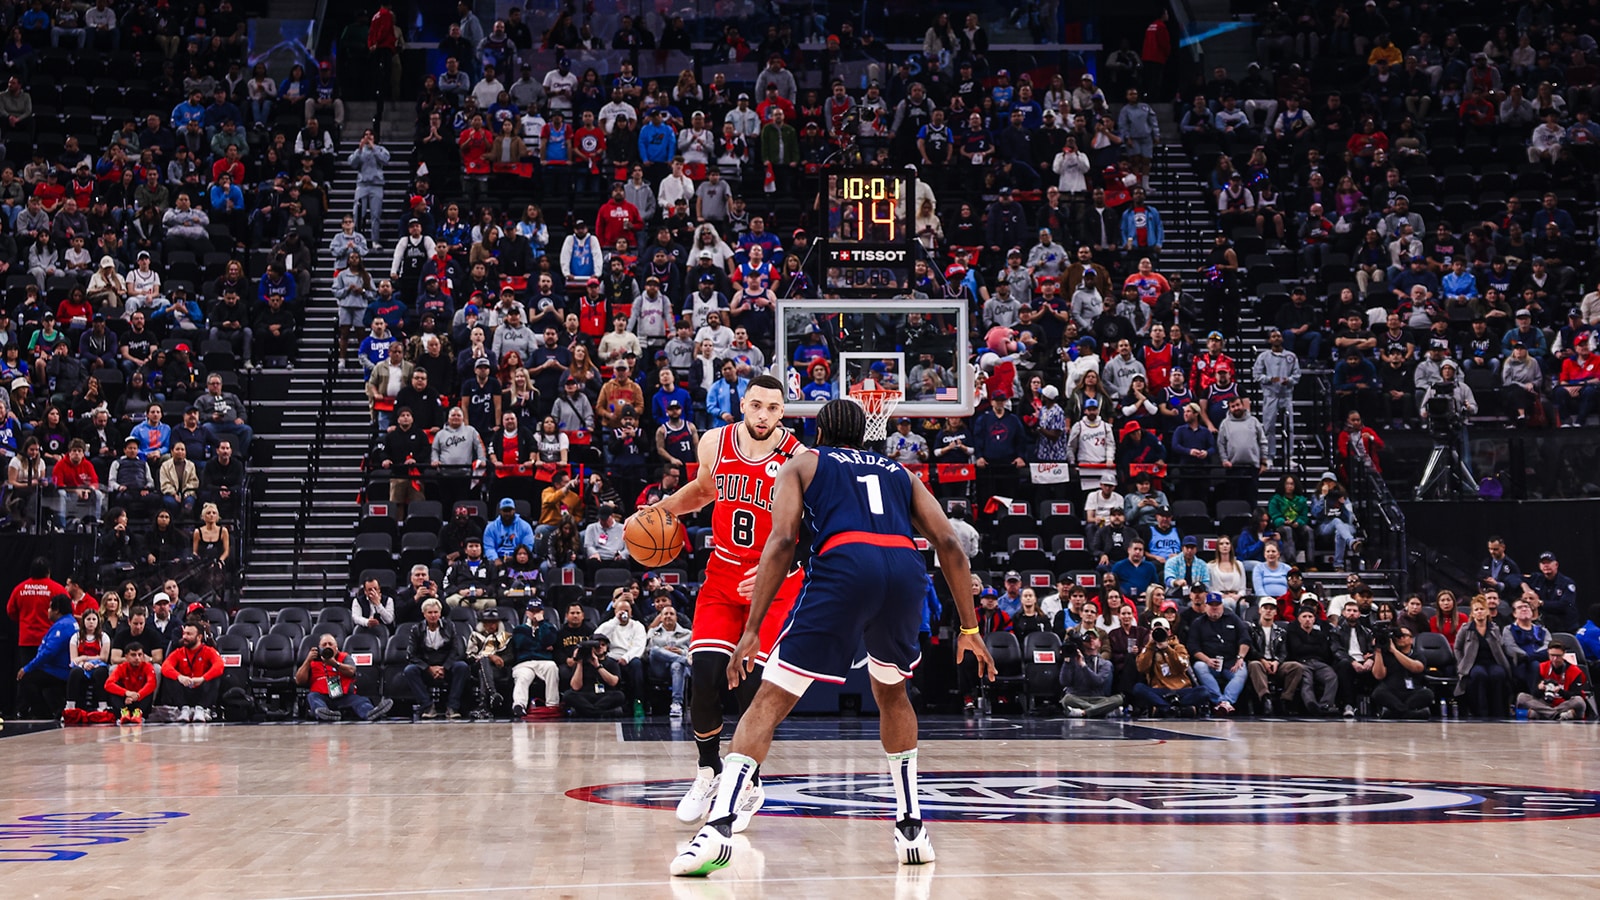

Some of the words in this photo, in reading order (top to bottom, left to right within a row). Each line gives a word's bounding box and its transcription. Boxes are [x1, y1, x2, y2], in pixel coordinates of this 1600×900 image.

[934, 141, 941, 150] 2
[979, 140, 985, 149] 2
[843, 178, 898, 200] 10:01
[856, 201, 894, 240] 14
[851, 250, 906, 262] TISSOT
[1443, 256, 1452, 265] 2
[411, 258, 417, 268] 2
[594, 318, 599, 327] 1
[503, 332, 522, 342] Clips
[378, 350, 385, 359] 2
[1117, 368, 1135, 378] Clips
[1161, 368, 1166, 378] 1
[484, 402, 490, 413] 2
[444, 436, 465, 448] Clips
[680, 441, 691, 451] 31
[1094, 438, 1105, 447] 24
[629, 444, 638, 454] 14
[857, 474, 886, 515] 1
[731, 508, 755, 549] 8
[1156, 539, 1178, 549] Clips
